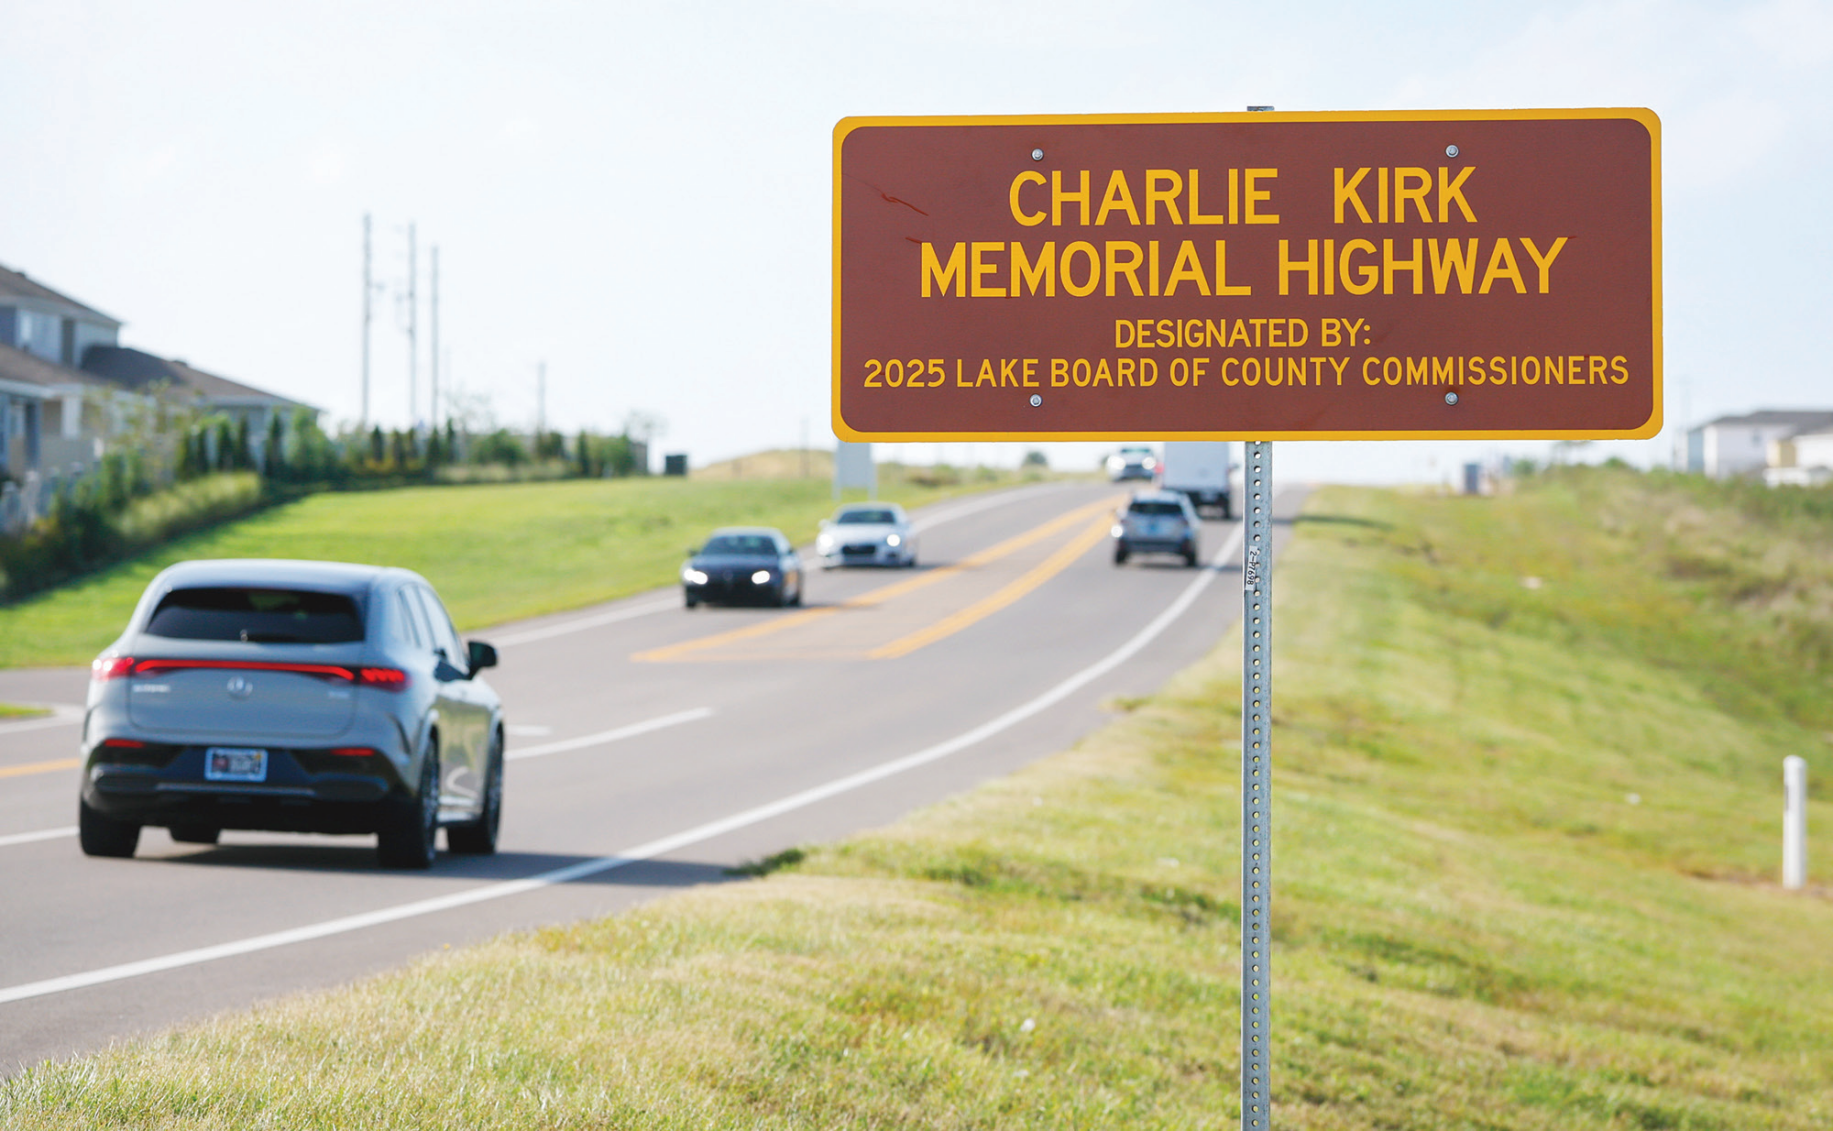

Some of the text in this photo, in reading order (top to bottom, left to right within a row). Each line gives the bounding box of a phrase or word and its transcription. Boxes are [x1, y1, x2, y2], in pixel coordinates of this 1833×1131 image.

[1009, 165, 1478, 227] CHARLIE KIRK
[921, 236, 1569, 298] MEMORIAL HIGHWAY
[1115, 318, 1371, 349] DESIGNATED BY:
[863, 355, 1629, 388] 2025 LAKE BOARD OF COUNTY COMMISSIONERS
